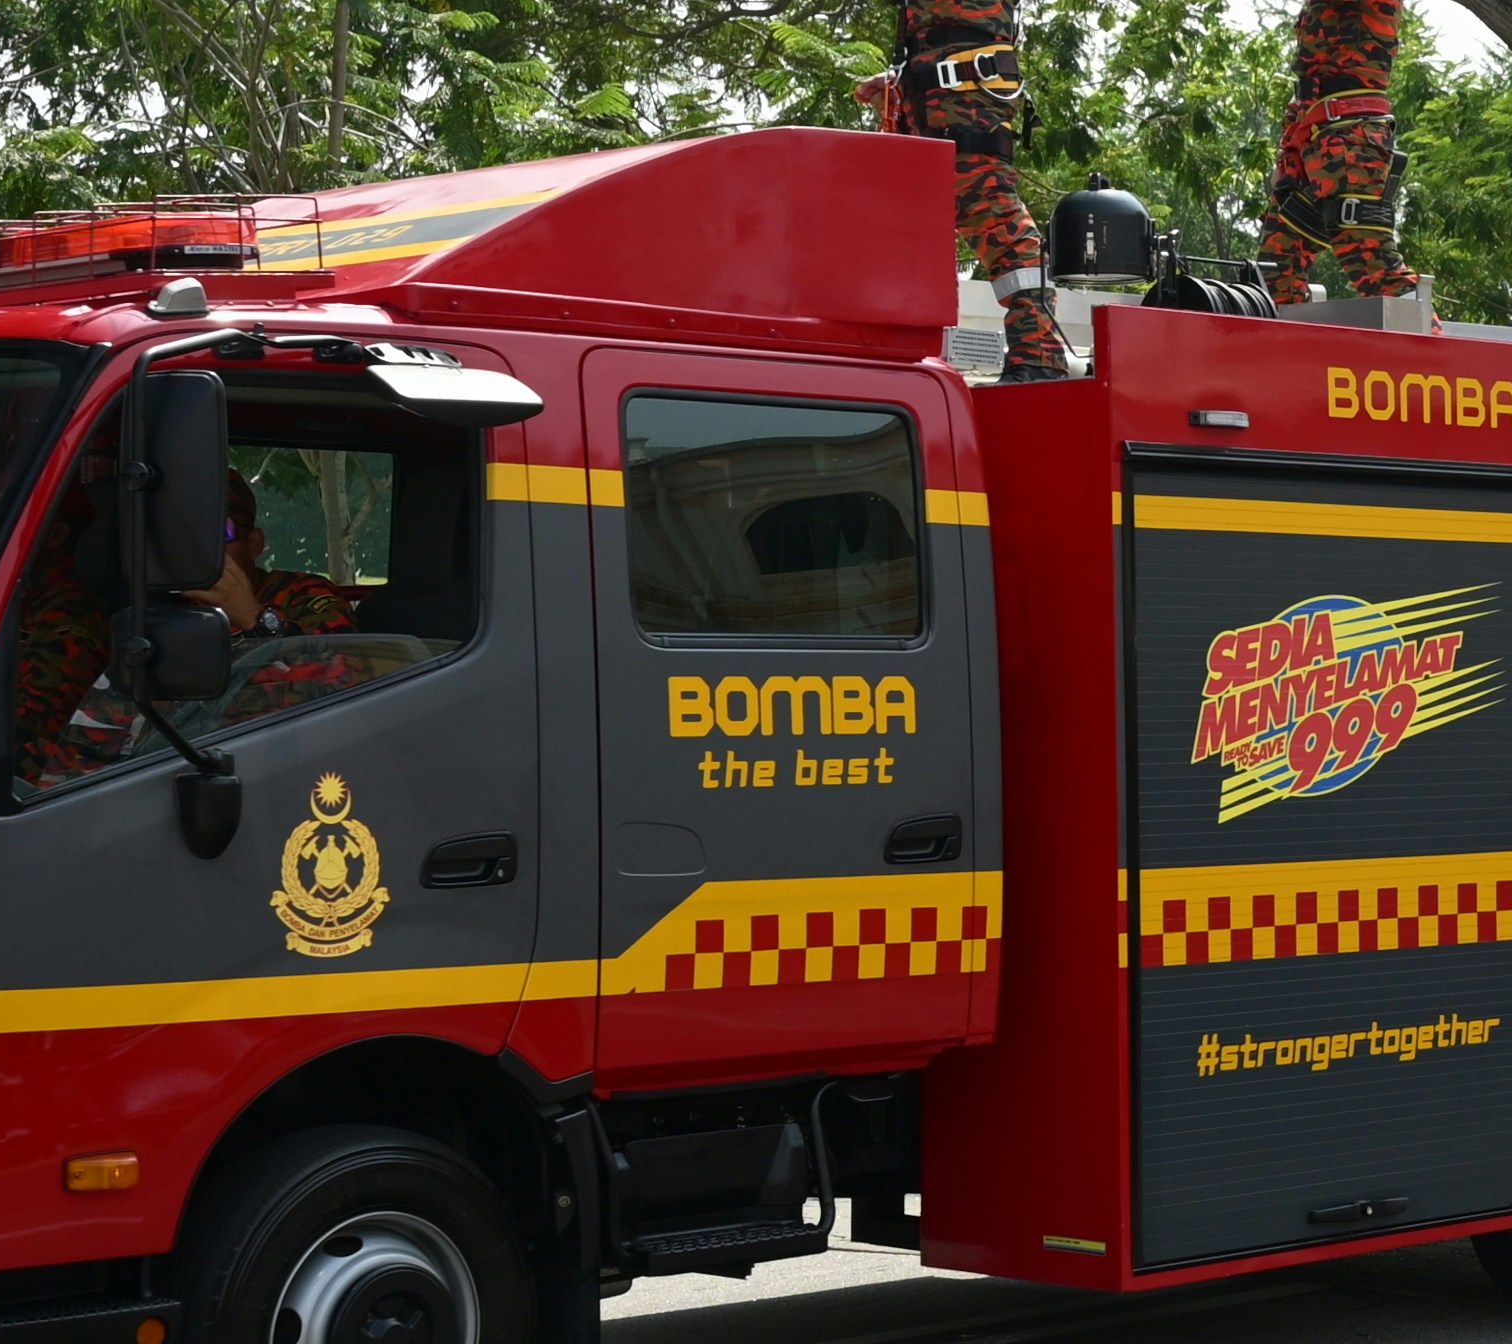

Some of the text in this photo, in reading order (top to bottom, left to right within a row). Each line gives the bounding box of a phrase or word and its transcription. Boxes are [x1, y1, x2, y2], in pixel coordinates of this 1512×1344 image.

[1205, 613, 1336, 695] SEDIA
[668, 676, 916, 737] BOMBA
[1194, 633, 1461, 761] MENYELAMAT
[1224, 740, 1252, 763] READY
[1237, 735, 1286, 769] TO SAVE
[1289, 684, 1417, 793] 999
[698, 747, 894, 788] the best
[279, 908, 379, 938] BOMBA DAN PENYELAMAT
[309, 944, 351, 955] MALAYSIA
[1197, 1013, 1500, 1077] #strongertogether
